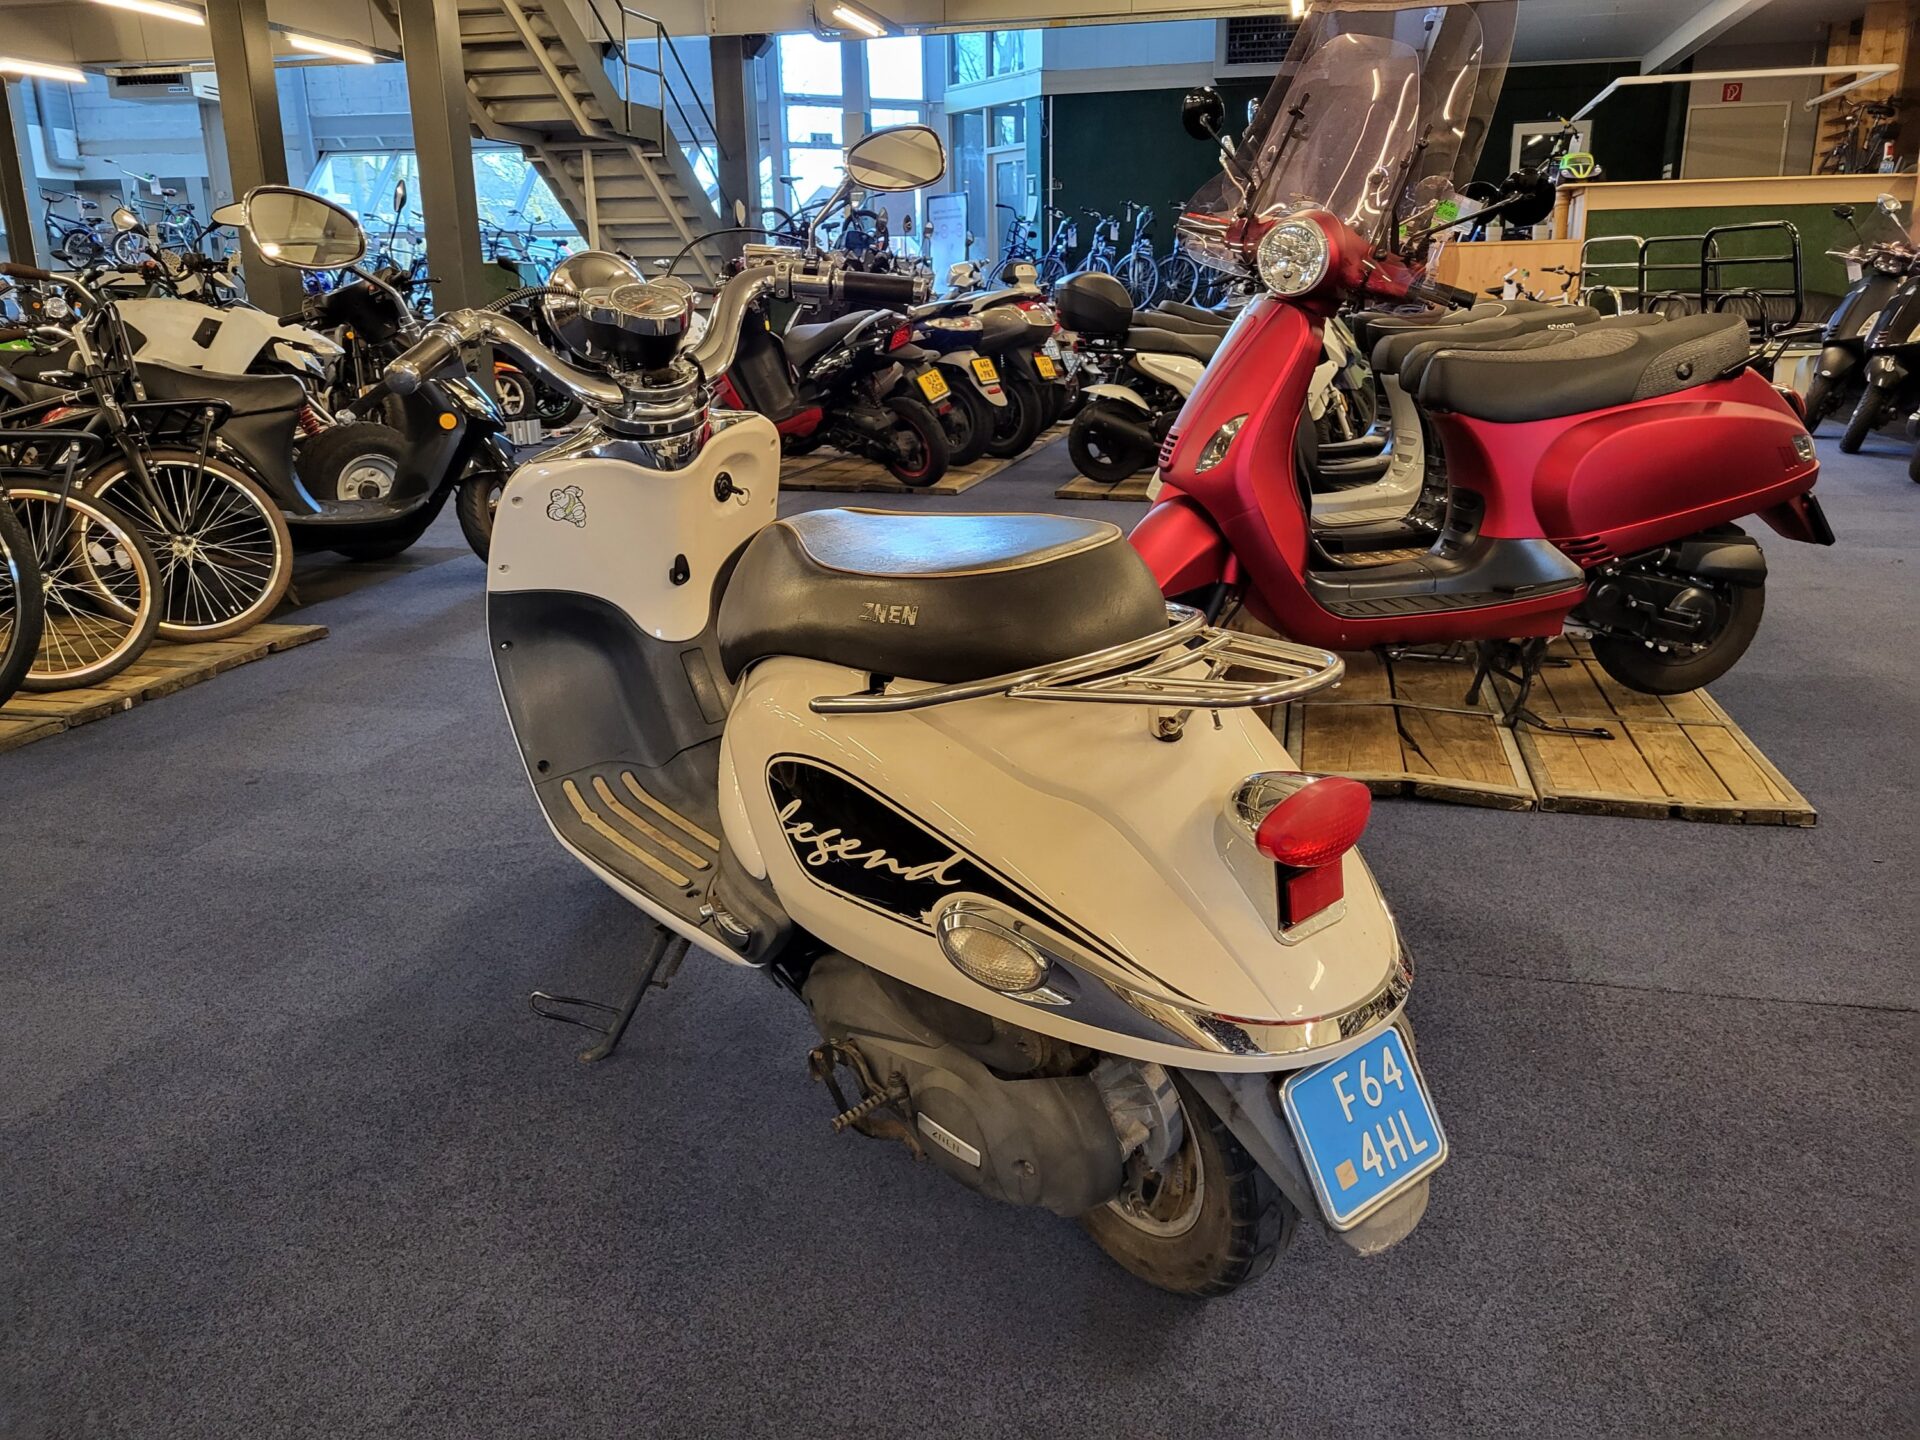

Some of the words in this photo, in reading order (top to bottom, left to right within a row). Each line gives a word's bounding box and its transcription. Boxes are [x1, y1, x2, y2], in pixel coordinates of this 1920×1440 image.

[858, 602, 919, 626] ZNEN
[1332, 1046, 1404, 1123] F64
[1362, 1109, 1429, 1178] 4HL
